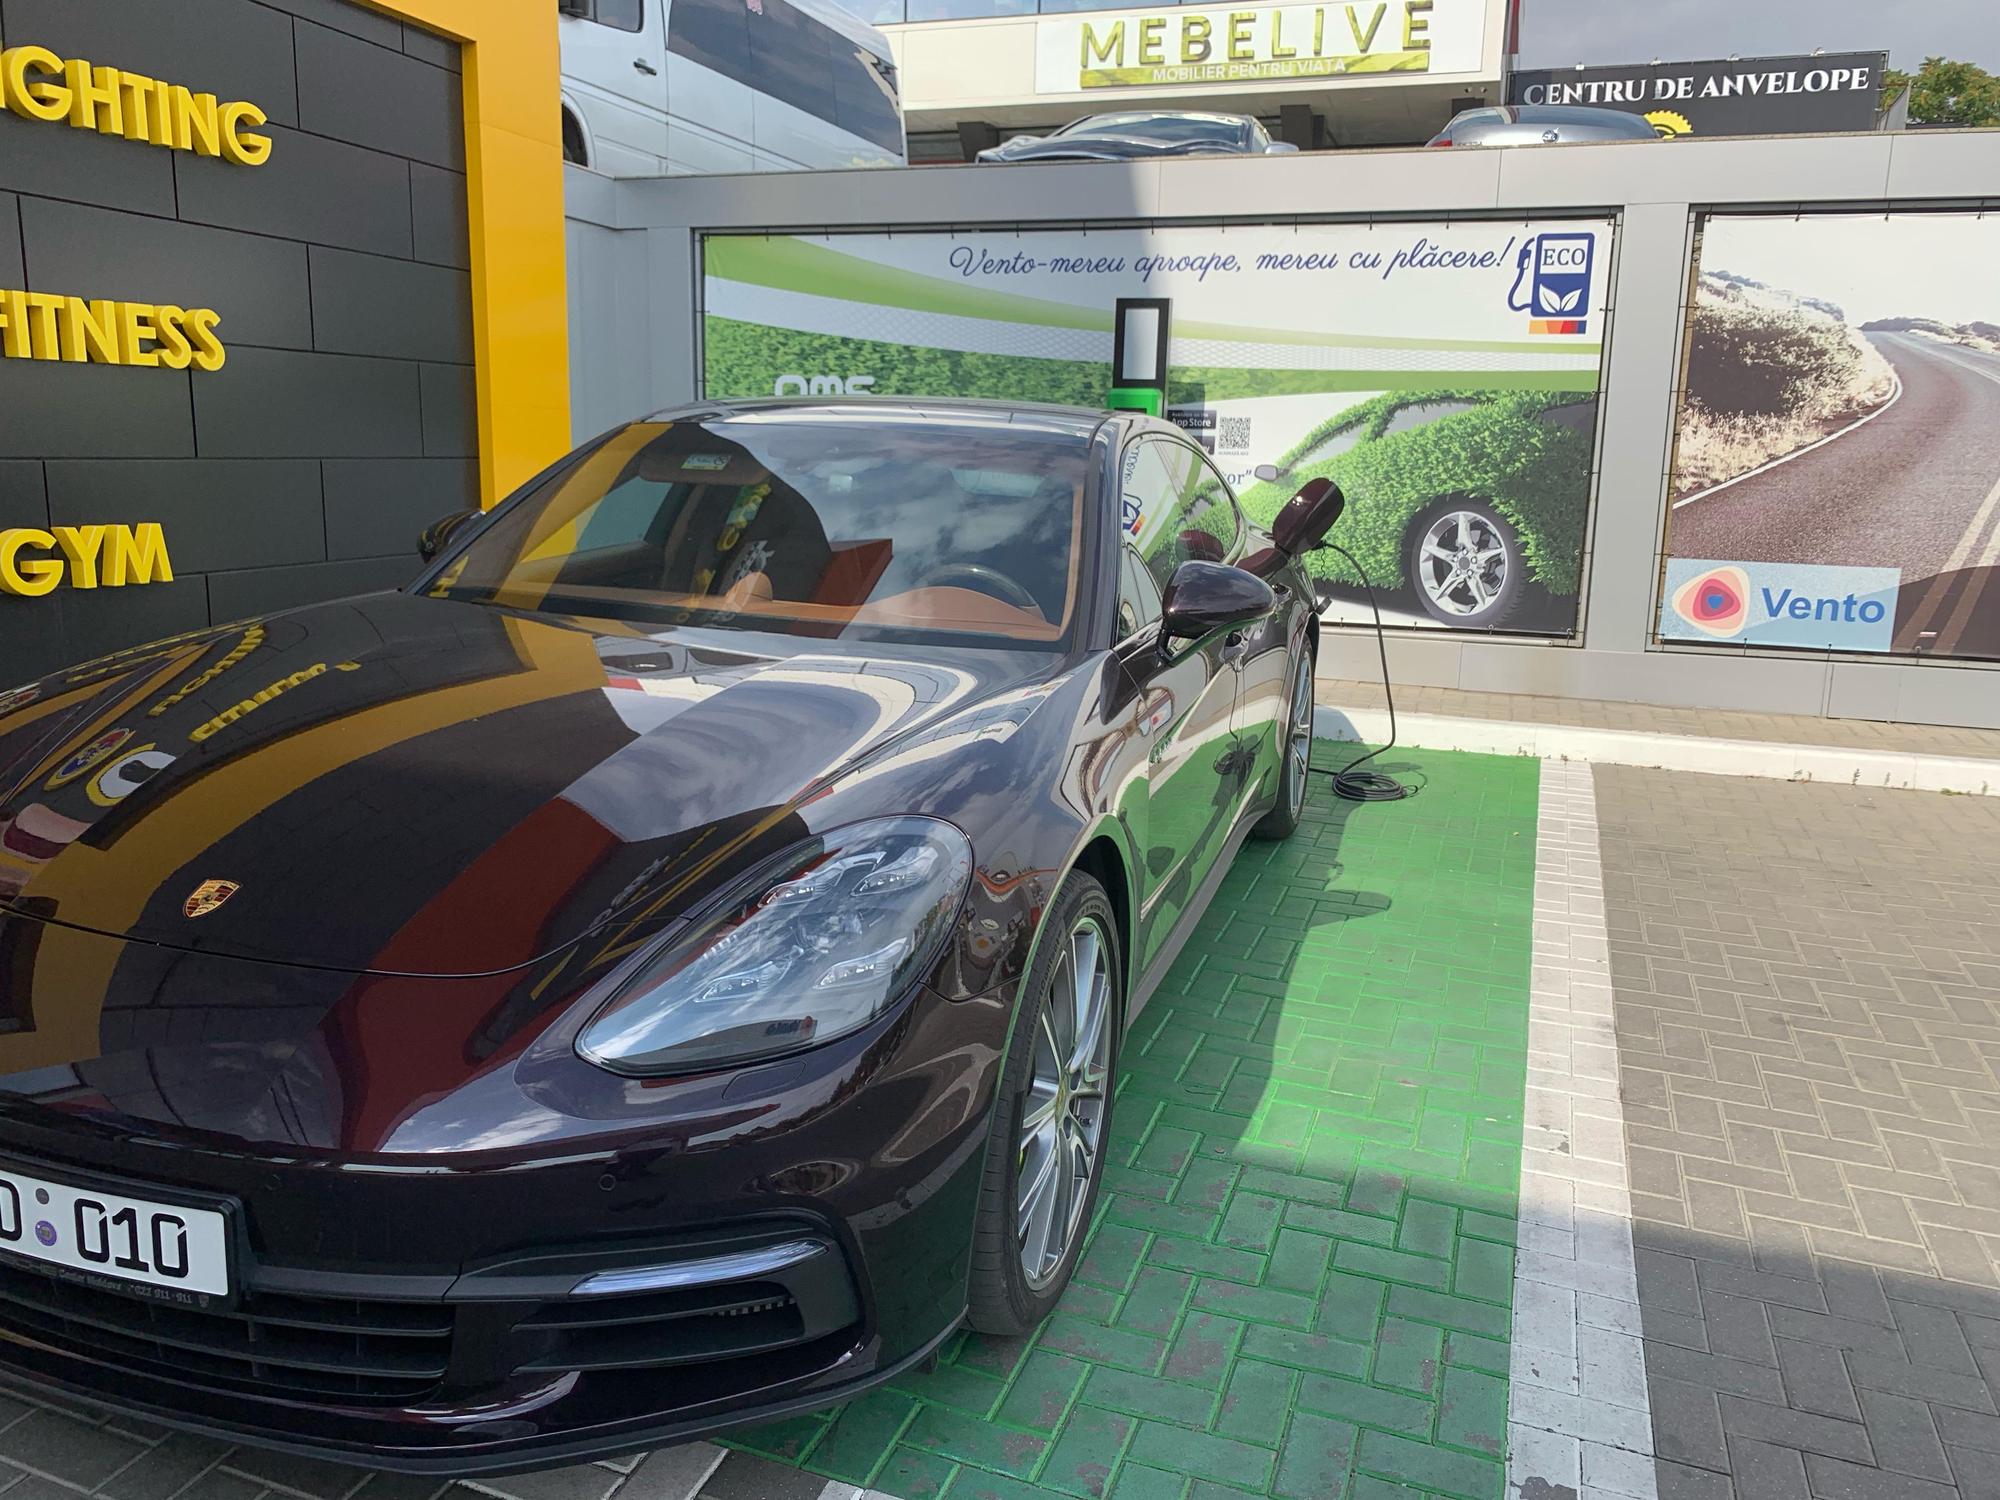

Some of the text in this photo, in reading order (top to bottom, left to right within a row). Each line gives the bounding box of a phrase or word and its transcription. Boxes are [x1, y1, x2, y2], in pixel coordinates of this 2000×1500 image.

[1081, 1, 1433, 67] MEBELIVE
[1153, 65, 1225, 82] MOBILIER
[1229, 61, 1291, 79] PENTRU
[1523, 67, 1870, 106] CENTRU DE ANVELOPE
[1134, 251, 1242, 283] aproape,
[1256, 250, 1338, 270] mereu
[1349, 250, 1381, 269] cu
[1382, 236, 1516, 280] plăcere!
[1542, 248, 1586, 267] ECO
[1189, 417, 1212, 427] Store
[0, 522, 174, 597] GYM
[1761, 587, 1885, 624] Vento
[74, 1198, 188, 1278] 010
